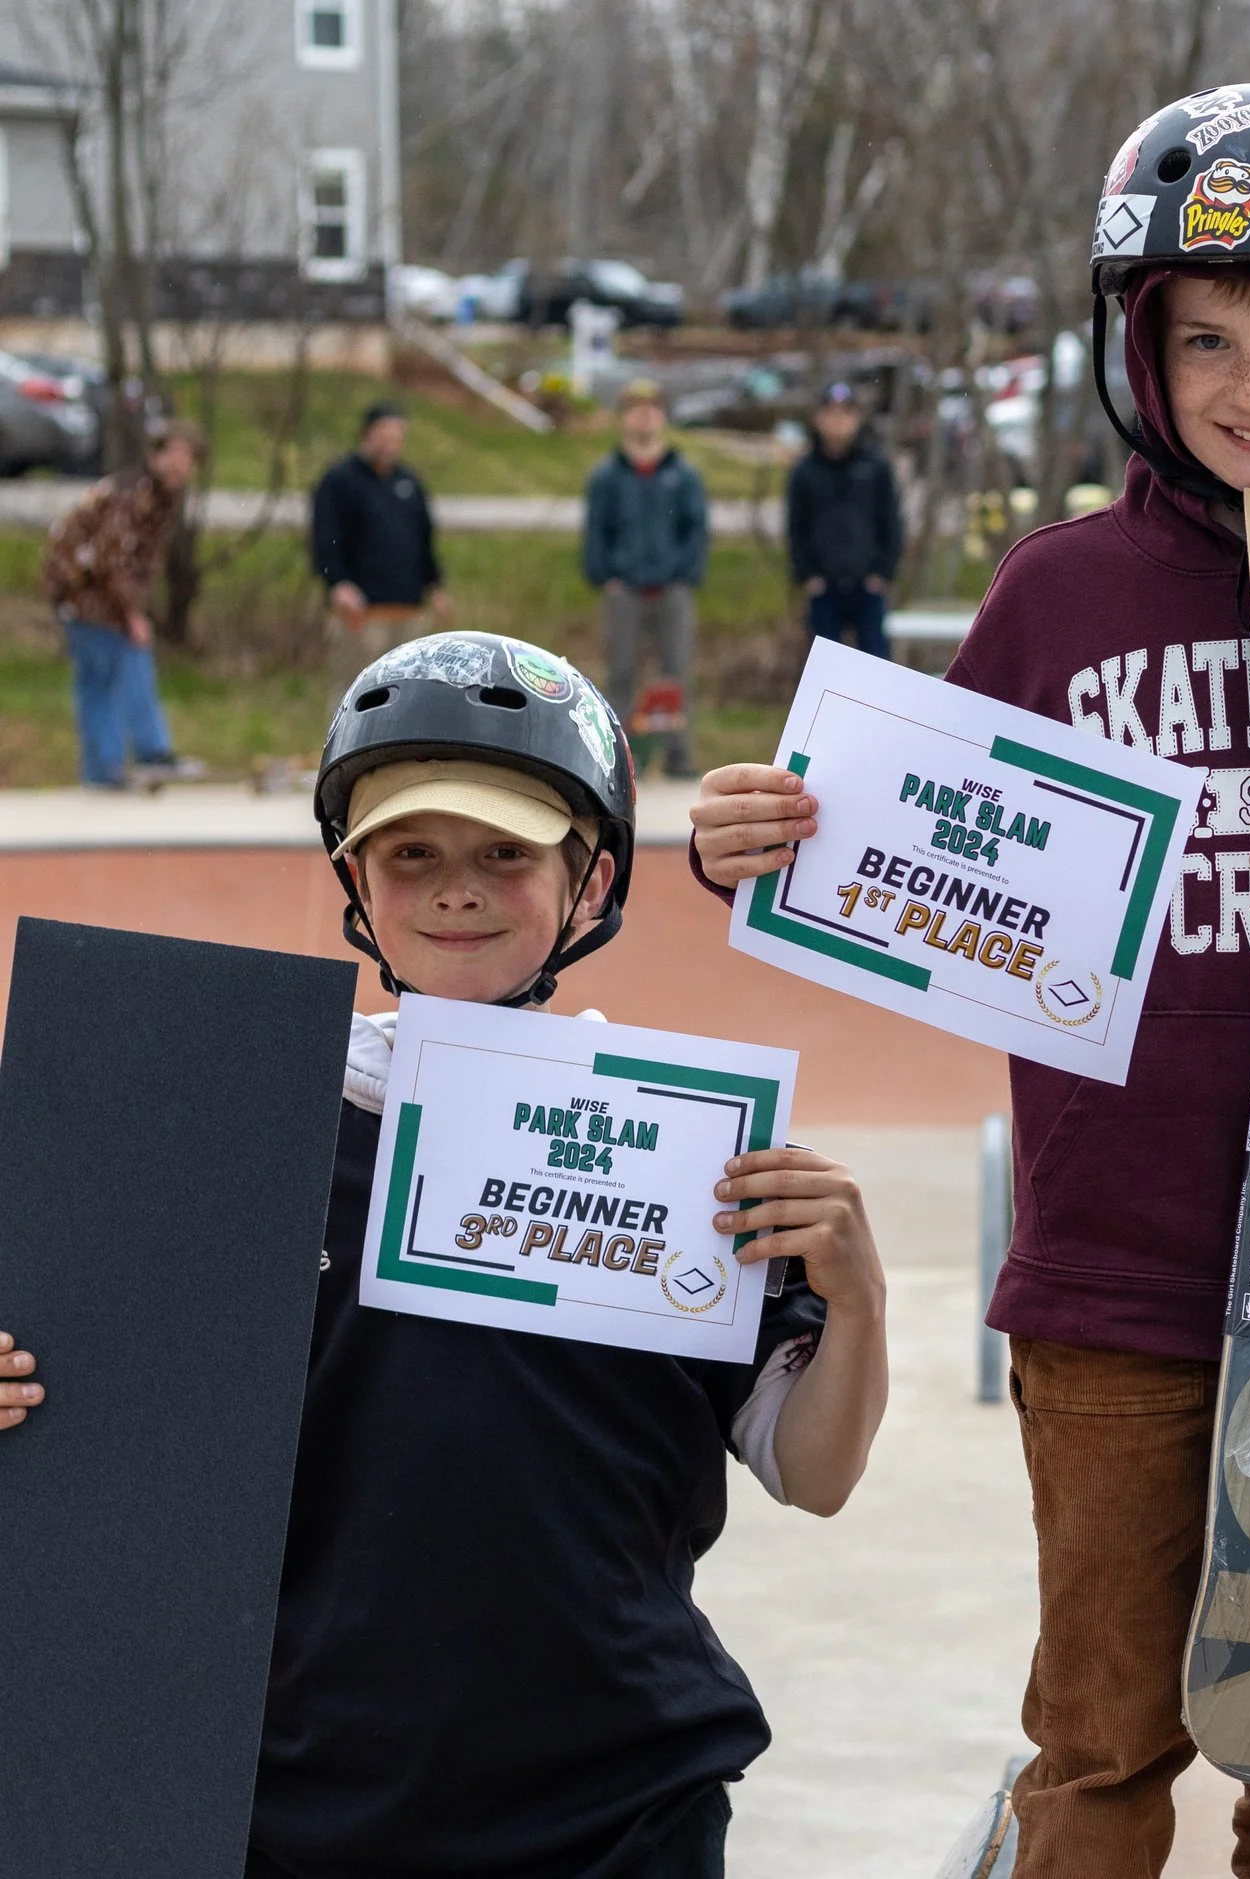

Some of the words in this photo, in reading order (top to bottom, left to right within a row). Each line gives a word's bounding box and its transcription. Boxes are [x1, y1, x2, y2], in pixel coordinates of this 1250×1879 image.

[1187, 204, 1249, 238] Pringles
[899, 773, 972, 823] PARK
[975, 800, 1051, 851] SLAM
[961, 778, 1003, 802] WISE
[912, 845, 926, 855] This
[927, 849, 960, 868] certificate
[960, 861, 967, 869] is
[967, 866, 1001, 882] presented
[1001, 876, 1009, 885] to
[931, 819, 1001, 867] 2024
[857, 846, 1051, 941] BEGINNER
[836, 880, 896, 920] 1ST
[895, 899, 1045, 983] PLACE
[513, 1102, 581, 1139] PARK
[587, 1114, 659, 1151] SLAM
[570, 1097, 610, 1114] WISE
[530, 1168, 543, 1176] This
[544, 1170, 576, 1182] certificate
[584, 1177, 617, 1188] presented
[547, 1139, 613, 1175] 2024
[478, 1177, 669, 1235] BEGINNER
[454, 1213, 518, 1251] 3RD
[519, 1221, 666, 1277] PLACE
[1230, 1236, 1240, 1283] Skateboard
[1236, 1195, 1246, 1234] Company
